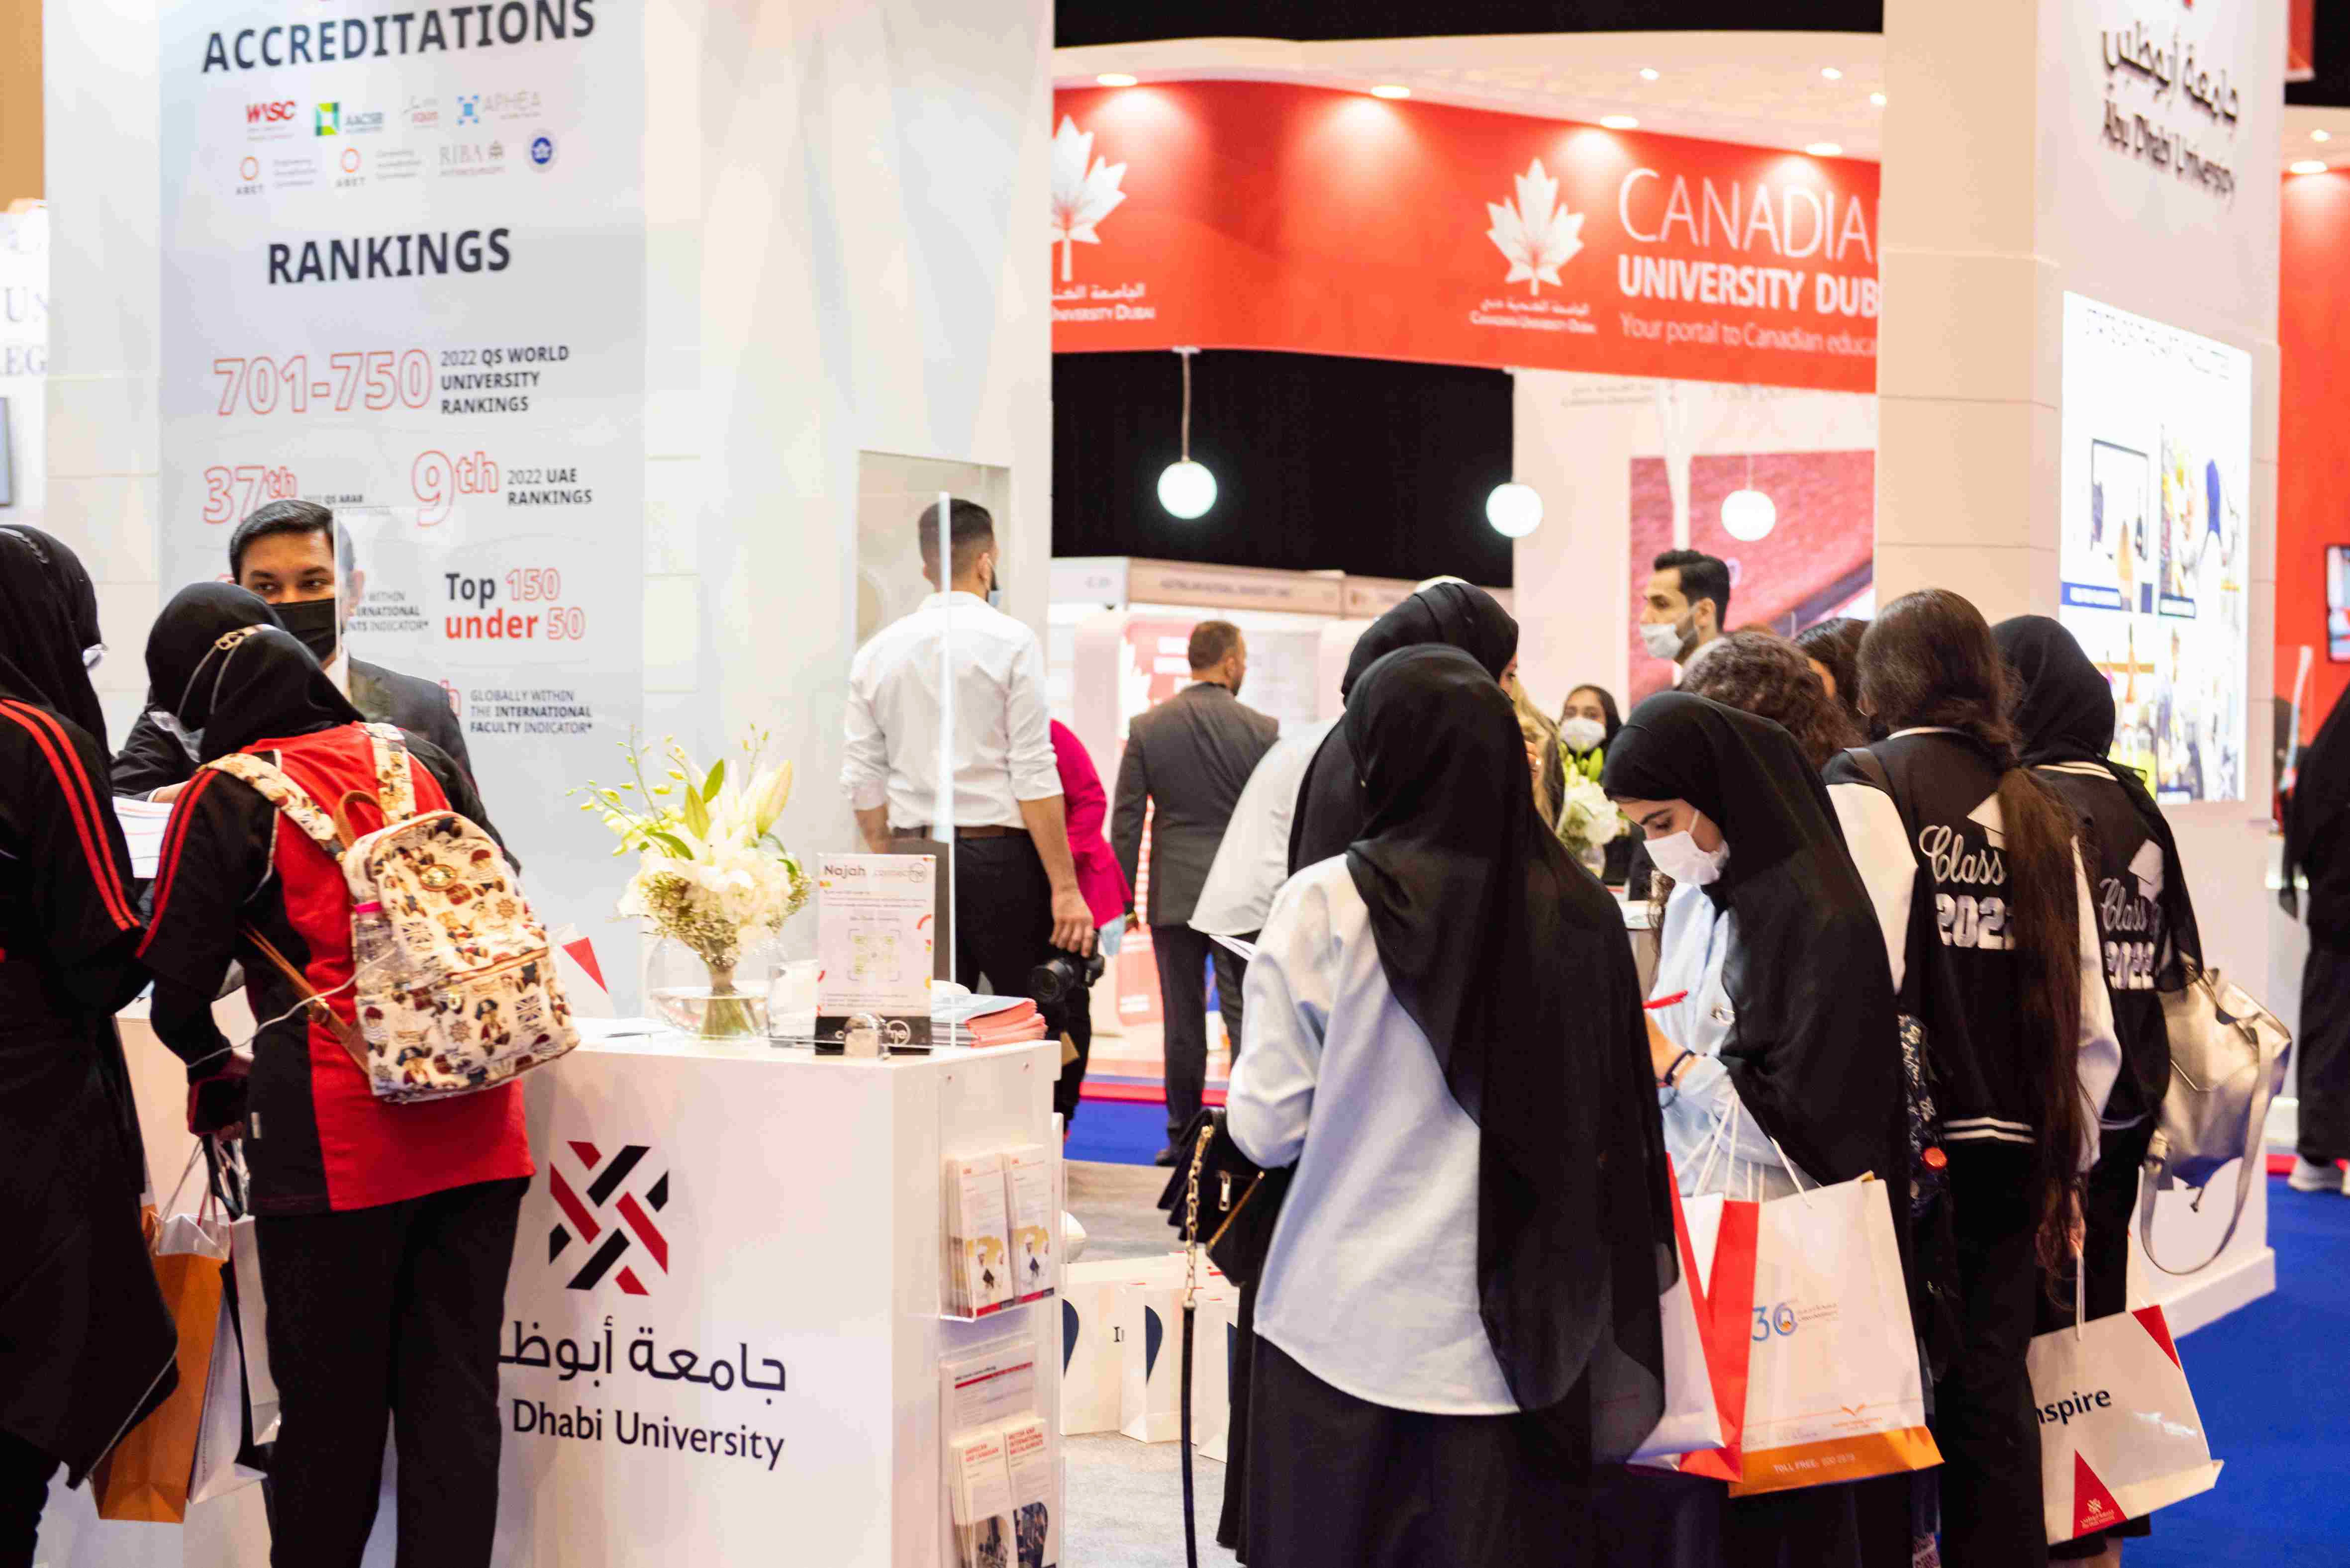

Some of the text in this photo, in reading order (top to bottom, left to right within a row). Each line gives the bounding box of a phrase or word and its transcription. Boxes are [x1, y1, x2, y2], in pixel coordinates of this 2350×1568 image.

[201, 0, 594, 74] ACCREDITATIONS
[1618, 167, 1878, 263] CANADIA
[268, 228, 512, 285] RANKINGS
[1618, 253, 1878, 318] UNIVERSITY DUB
[441, 345, 570, 367] 2022 QS WORLD
[1620, 313, 1877, 357] Your portal to Canadian educa
[212, 349, 432, 416] 701-750
[441, 371, 540, 391] UNIVERSITY
[441, 396, 529, 415] RANKINGS
[201, 465, 298, 525] 37th
[411, 450, 499, 527] 9th
[507, 467, 578, 486] 2022 UAE
[507, 490, 592, 507] RANKINGS
[446, 568, 561, 609] Top 150
[445, 607, 586, 640] under 50
[470, 688, 574, 704] GLOBALLY WITHIN
[470, 704, 592, 719] THE INTERNATIONAL
[470, 721, 522, 736] FACULTY
[824, 864, 867, 880] Najah
[1919, 824, 2007, 885] Class
[499, 1315, 786, 1405] جامعة أبوظ
[512, 1398, 784, 1471] Dhabi University
